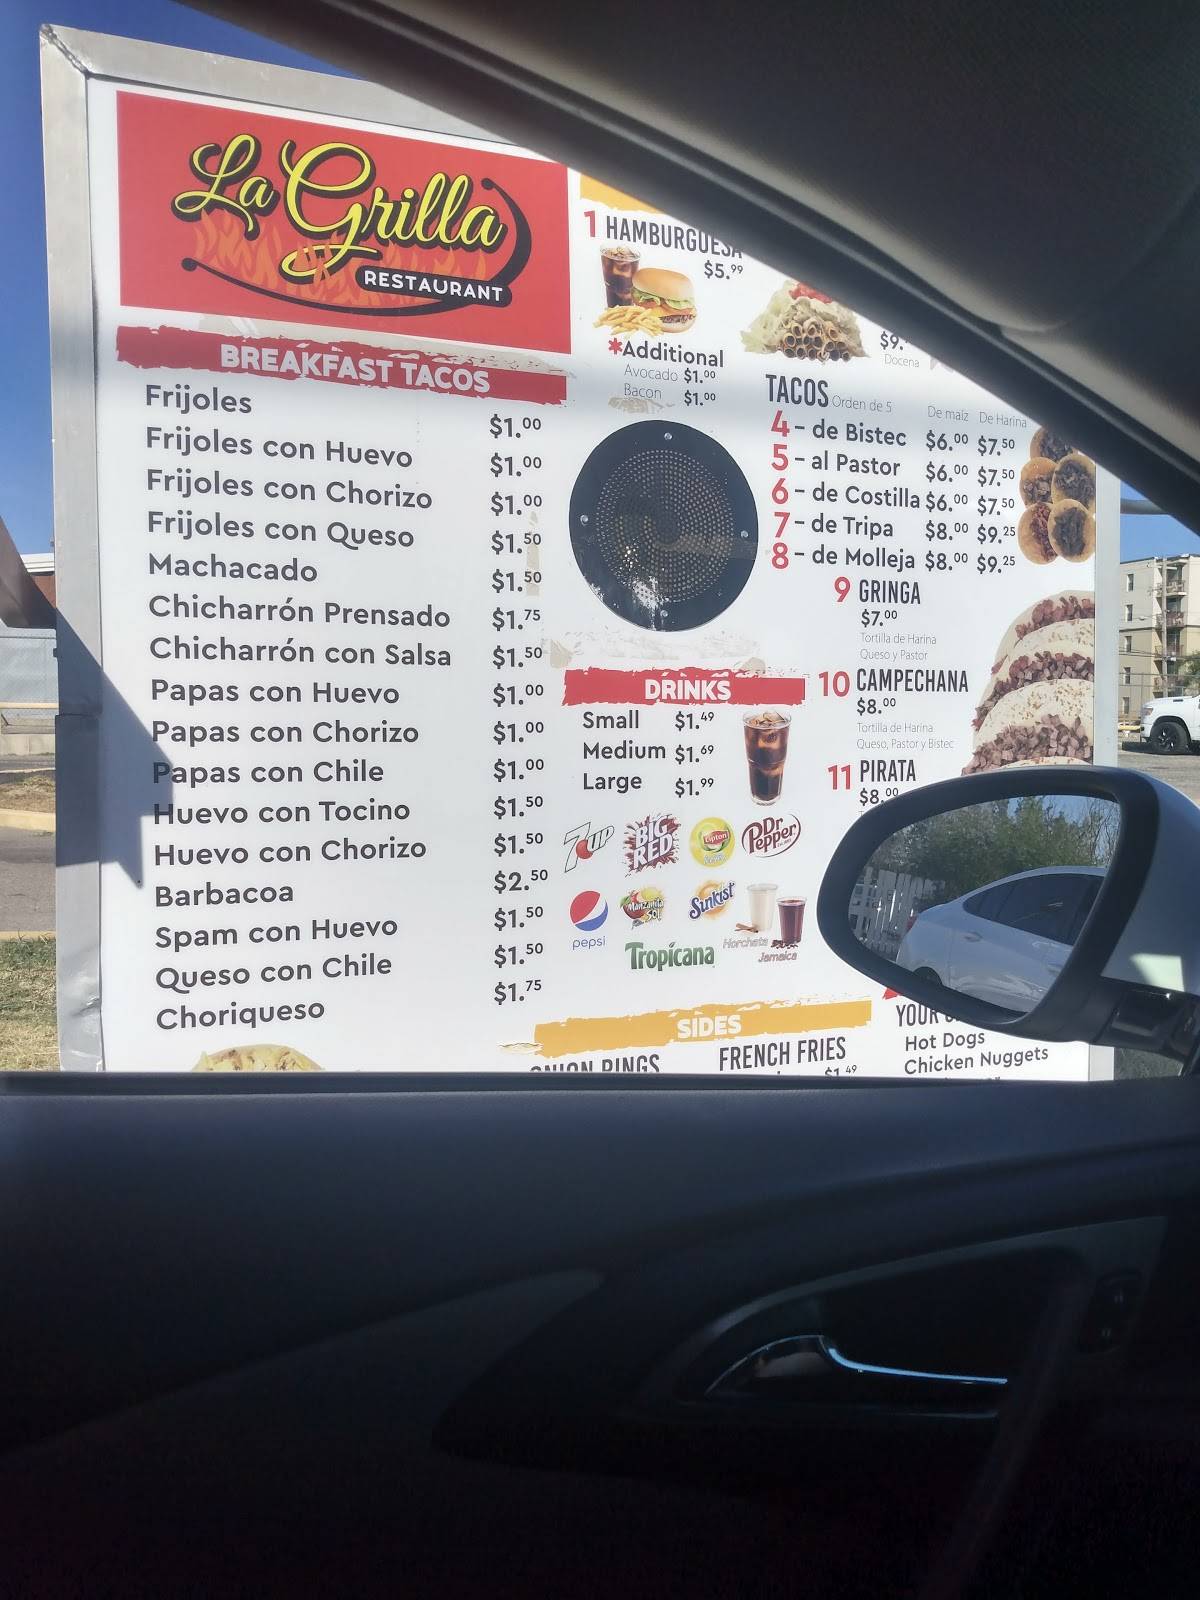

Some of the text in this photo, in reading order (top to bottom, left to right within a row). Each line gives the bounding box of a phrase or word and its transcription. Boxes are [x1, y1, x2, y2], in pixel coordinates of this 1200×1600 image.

[171, 133, 508, 285] La Grilla
[584, 210, 595, 237] 1
[704, 260, 743, 279] $5.99
[363, 269, 503, 302] RESTAURANT
[220, 343, 490, 393] BREAKFAST TACOS
[624, 364, 715, 383] Avocado $1.00
[885, 354, 919, 368] Docena
[624, 383, 715, 406] Bacon $1.00
[766, 374, 891, 413] TACOS Orden de 5
[146, 384, 542, 438] Frijoles $1.00
[928, 406, 942, 418] De
[980, 412, 1027, 428] De Harina
[146, 426, 542, 478] Frijoles con Huevo $1.00
[812, 418, 838, 440] de
[846, 422, 906, 446] Bistec
[926, 430, 968, 452] $6.00
[978, 434, 1016, 456] $7.50
[812, 450, 828, 470] al
[836, 454, 900, 476] Pastor
[926, 460, 968, 482] $6.00
[978, 466, 1014, 488] $7.50
[148, 468, 542, 516] Frijoles con Chorizo $1.00
[812, 482, 838, 502] de
[846, 486, 920, 508] Costilla
[926, 490, 968, 512] $6.00
[978, 496, 1014, 516] $7.50
[148, 510, 542, 556] Frijoles con Queso $1.50
[812, 512, 838, 534] de
[842, 516, 894, 540] Tripa
[926, 520, 968, 542] $8.00
[978, 524, 1016, 544] $9.25
[150, 552, 542, 594] Machacado $1.50
[812, 544, 838, 564] de
[846, 546, 914, 572] Molleja
[926, 550, 968, 572] $8.00
[976, 554, 1016, 574] $9.25
[834, 576, 920, 604] 9 GRINGA
[148, 594, 540, 632] Chicharrón Prensado $1.75
[862, 608, 898, 628] $7.00
[150, 634, 542, 670] Chicharrón con Salsa $1.50
[861, 633, 936, 645] Tortilla de Harina
[860, 649, 928, 661] Queso y Pastor
[152, 678, 544, 708] Papas con Huevo $1.00
[645, 678, 732, 700] DRINKS
[818, 668, 968, 697] 10 CAMPECHANA
[582, 710, 714, 732] Small $1.49
[856, 696, 896, 716] $8.00
[152, 720, 544, 747] Papas con Chorizo $1.00
[858, 722, 933, 733] Tortilla de Harina
[584, 740, 714, 764] Medium $1.69
[857, 739, 953, 750] Queso, Pastor y Bistec
[153, 758, 544, 788] Papas con Chile $1.00
[584, 772, 714, 798] Large $1.99
[828, 760, 916, 790] 11 PIRATA
[154, 796, 544, 825] Huevo con Tocino $1.50
[635, 816, 668, 849] BIG
[705, 833, 727, 843] Lipton
[749, 822, 796, 854] Pepper
[763, 817, 783, 836] Dr
[154, 832, 544, 866] Huevo con Chorizo $1.50
[633, 833, 673, 870] RED
[156, 870, 548, 908] Barbacoa $2.50
[689, 882, 734, 919] Sunkist
[156, 906, 544, 952] Spam con Huevo $1.50
[572, 936, 605, 950] pepsi
[156, 942, 544, 994] Queso con Chile $1.50
[625, 941, 714, 971] Tropicana
[758, 951, 797, 962] Jamaica
[156, 980, 542, 1030] Choriqueso $1.75
[896, 1003, 938, 1027] YOUR
[677, 1014, 742, 1038] SIDES
[720, 1036, 846, 1072] FRENCH FRIES
[906, 1032, 984, 1052] Hot Dogs
[904, 1048, 1048, 1074] Chicken Nuggets
